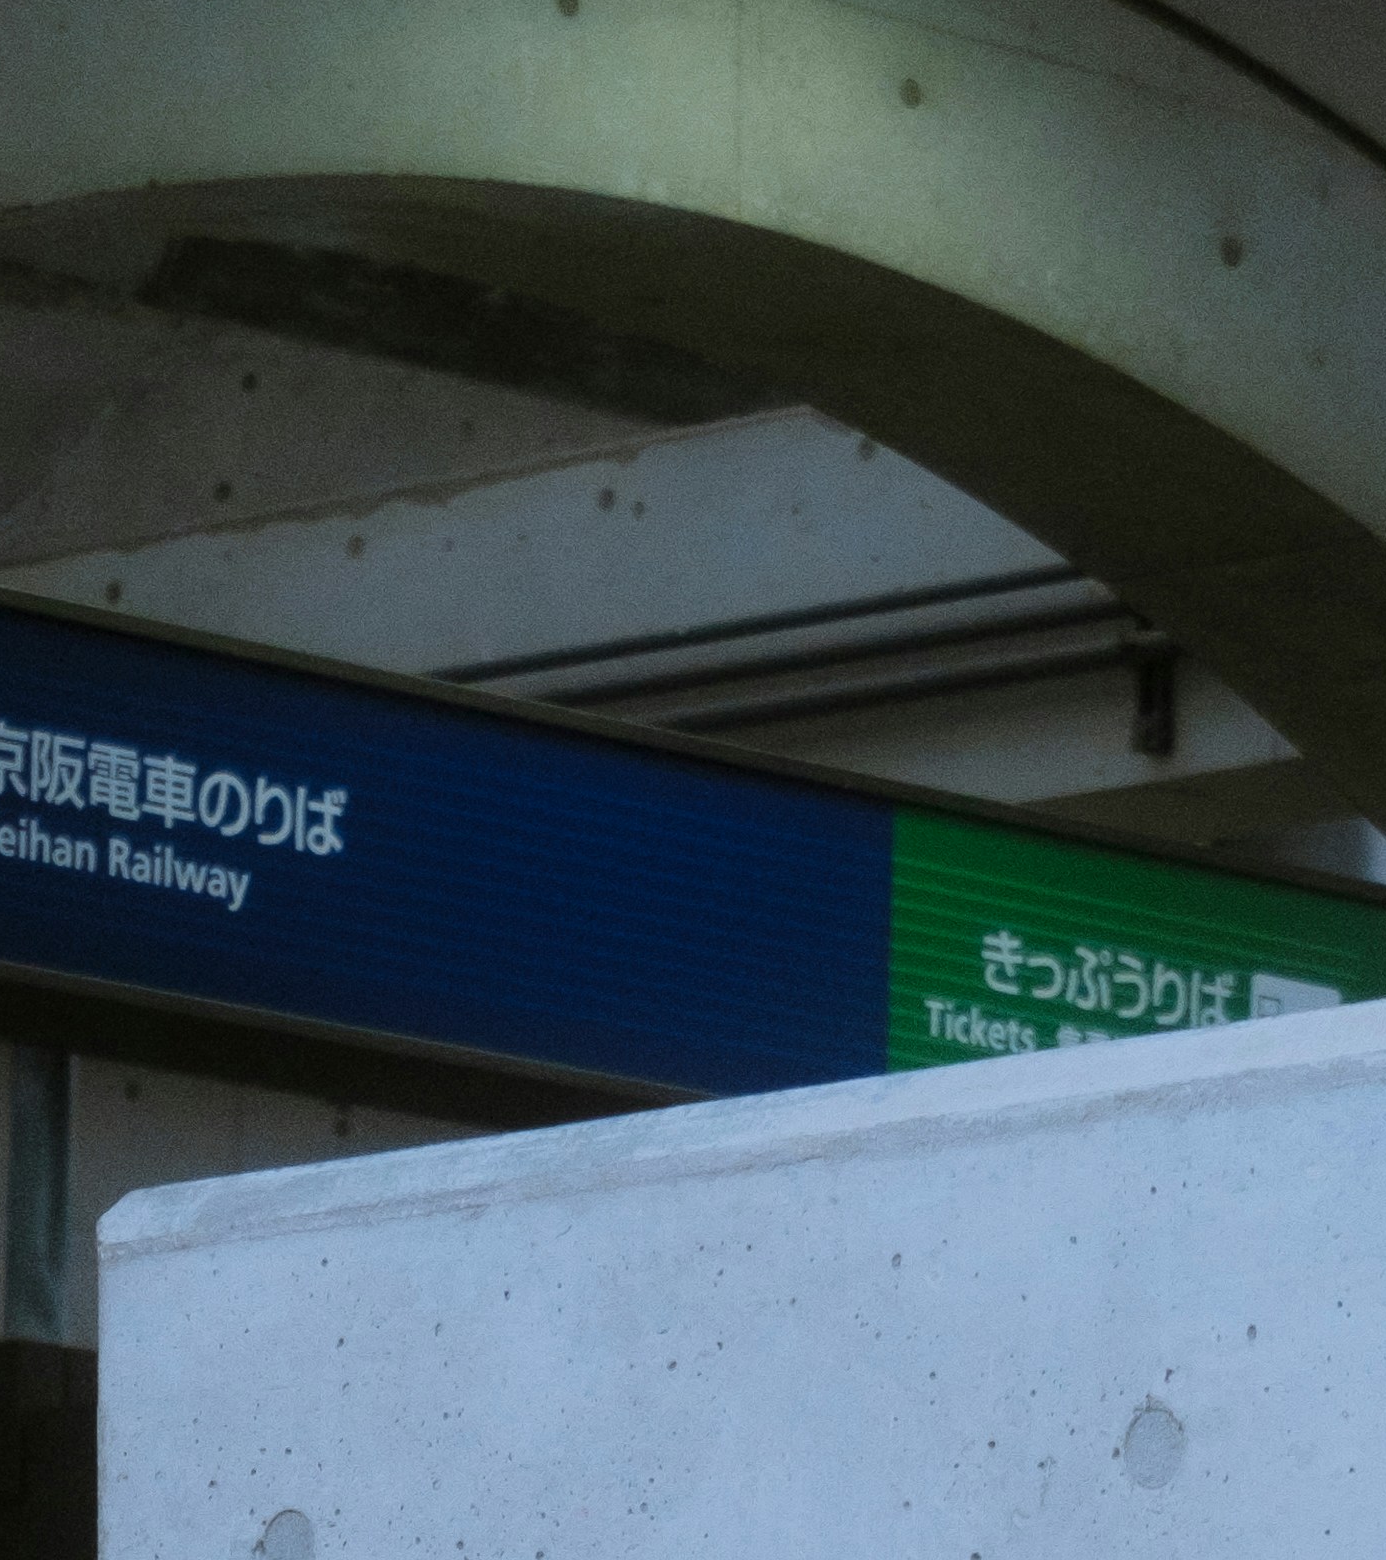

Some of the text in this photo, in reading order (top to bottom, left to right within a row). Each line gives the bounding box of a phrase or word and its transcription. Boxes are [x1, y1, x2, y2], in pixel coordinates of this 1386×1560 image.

[108, 837, 250, 913] Railway
[980, 929, 1239, 1028] きっぷうりば
[923, 998, 1037, 1052] Tickets
